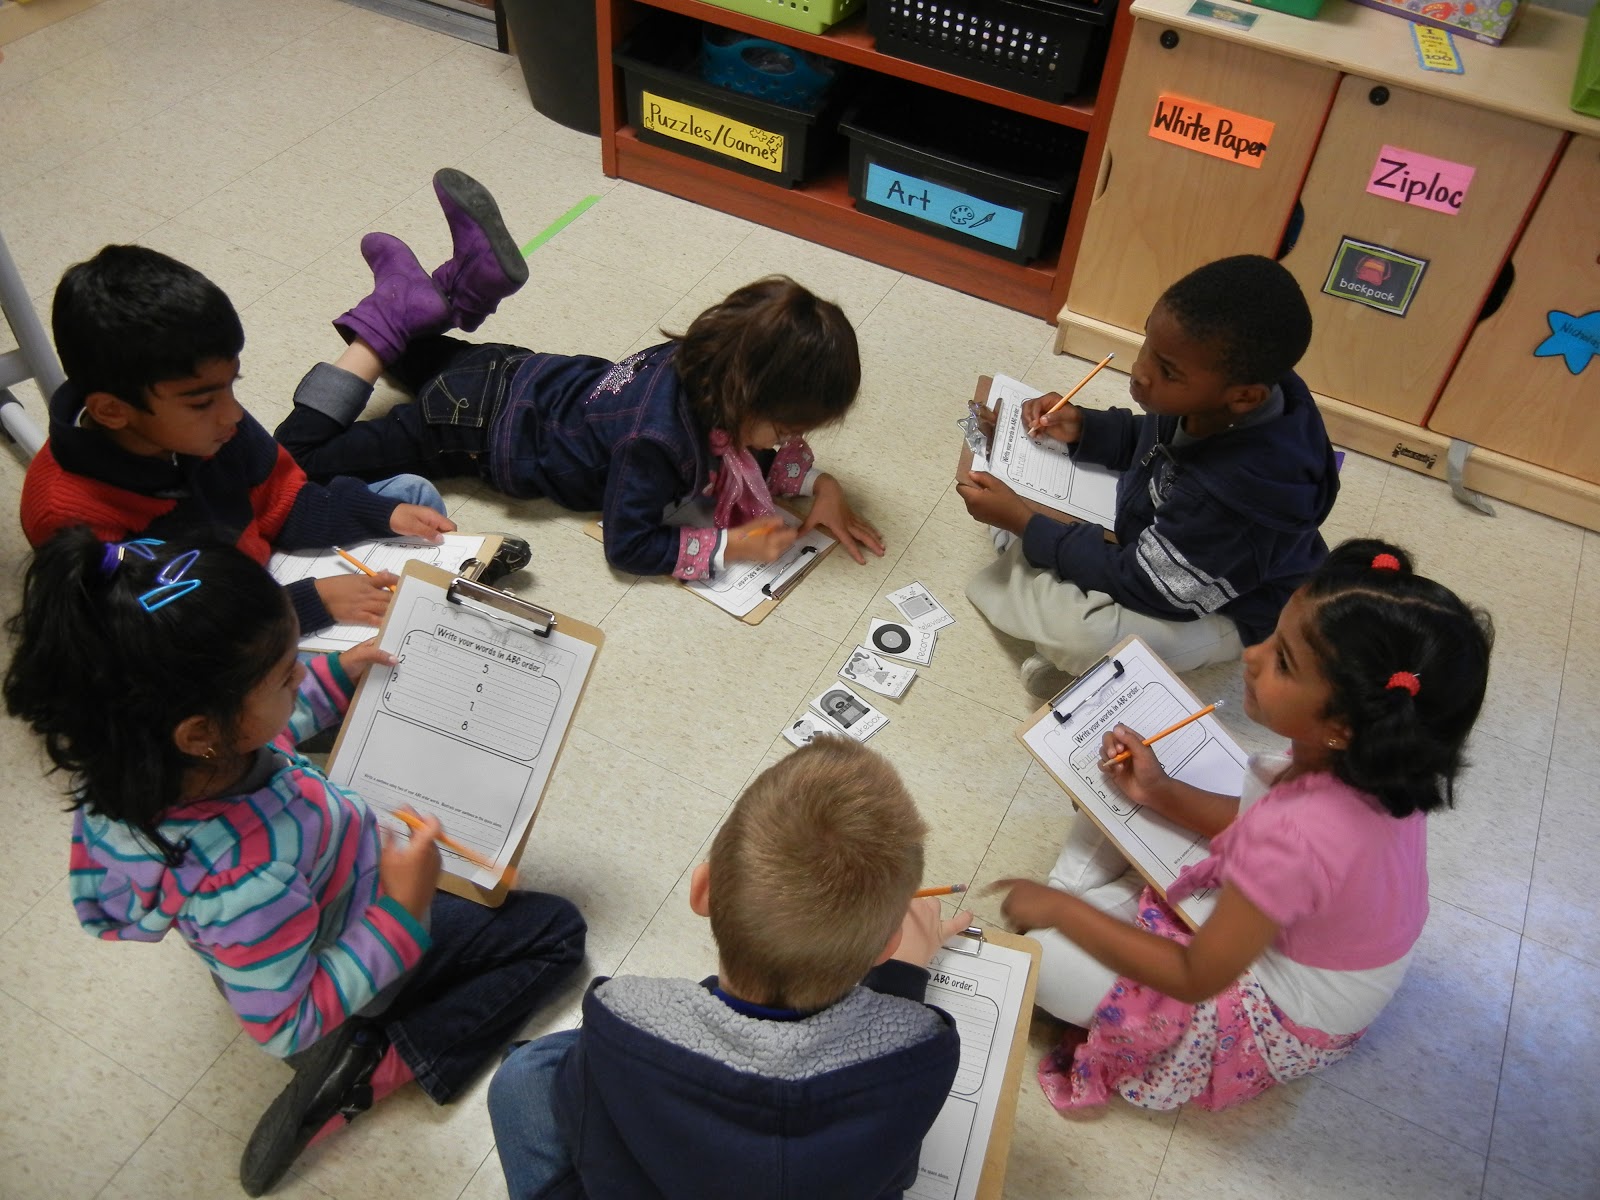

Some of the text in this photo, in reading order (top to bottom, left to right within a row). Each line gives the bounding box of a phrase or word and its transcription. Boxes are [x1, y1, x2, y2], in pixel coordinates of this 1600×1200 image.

[650, 102, 777, 164] Puzzles/Games
[1154, 101, 1267, 159] White Paper
[886, 180, 930, 210] Art
[1373, 158, 1463, 208] Ziploc
[1340, 278, 1394, 302] backpack
[437, 628, 540, 672] Write your words in ABC order.
[916, 631, 930, 660] record
[852, 714, 882, 741] jukebox
[1074, 730, 1090, 744] Write
[1089, 721, 1100, 733] your
[1099, 708, 1114, 722] words
[1116, 696, 1128, 708] ABC
[933, 974, 950, 984] ABC
[952, 980, 973, 991] order.
